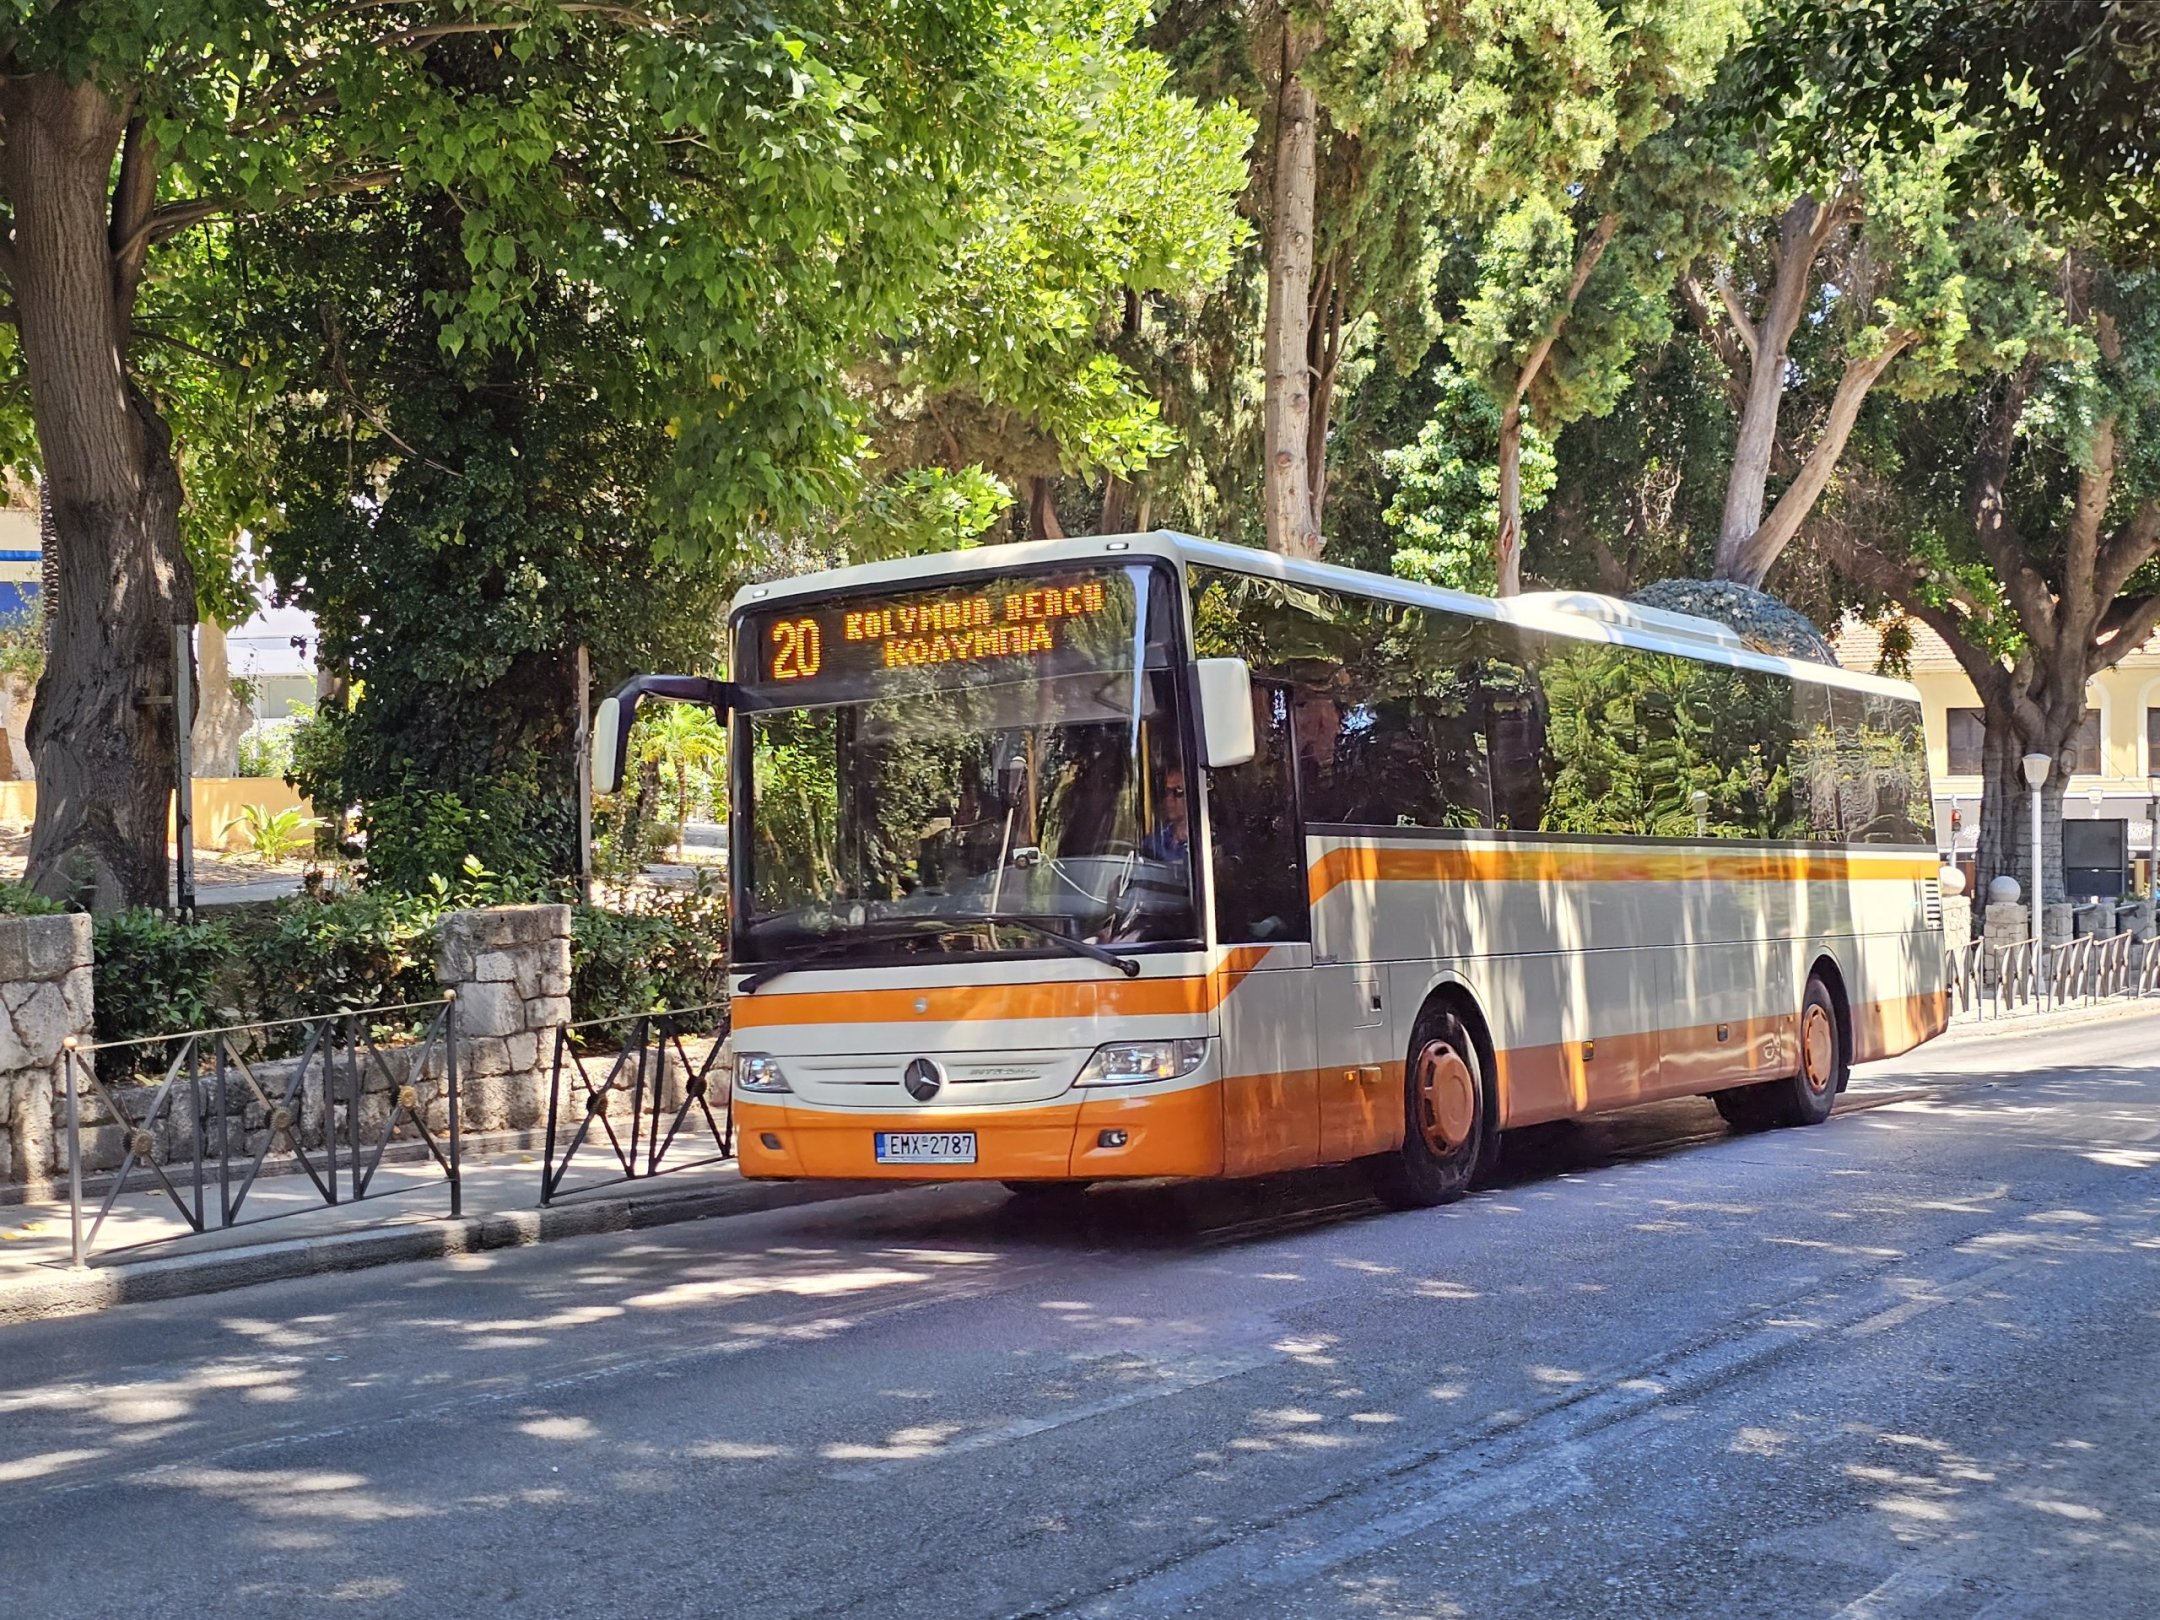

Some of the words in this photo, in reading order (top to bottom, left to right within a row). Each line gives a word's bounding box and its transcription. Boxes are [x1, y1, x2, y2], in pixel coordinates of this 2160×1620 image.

[845, 597, 991, 640] KOLYMBIA
[1005, 584, 1104, 621] BEACH
[771, 618, 821, 679] 20
